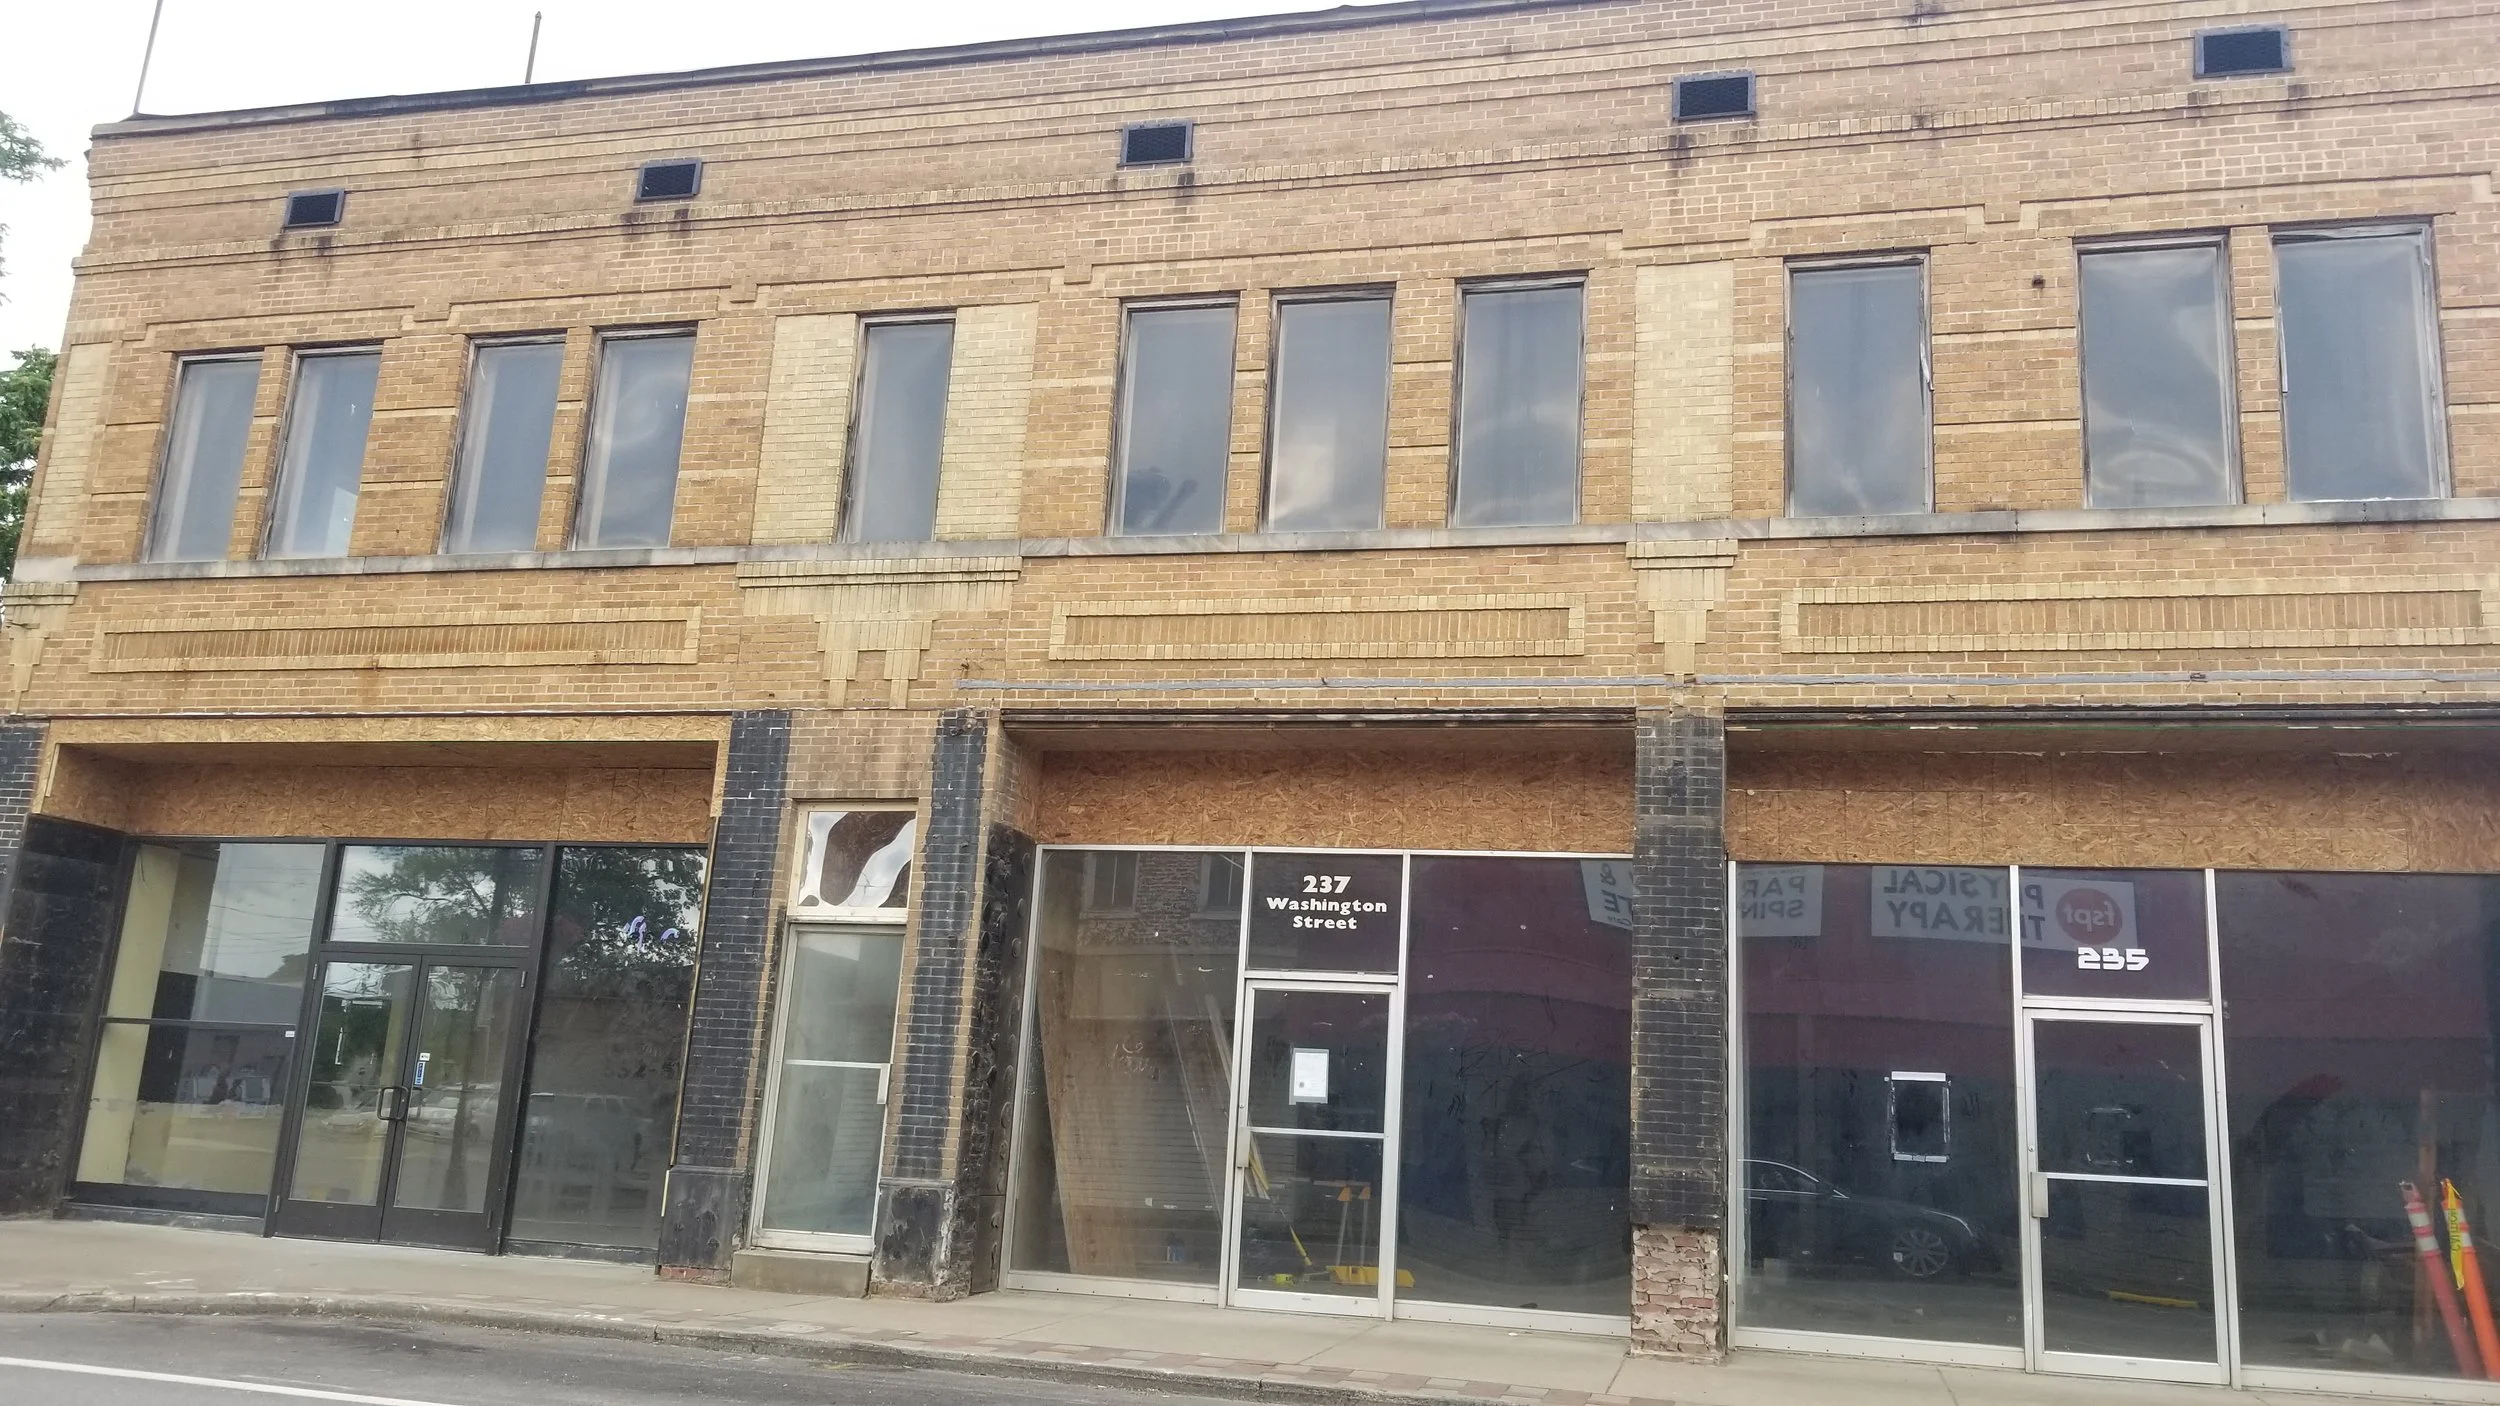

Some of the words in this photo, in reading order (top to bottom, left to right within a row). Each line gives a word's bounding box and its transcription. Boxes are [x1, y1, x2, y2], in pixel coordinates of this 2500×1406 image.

[1303, 875, 1352, 893] 237
[1266, 897, 1387, 915] Washington
[1293, 915, 1357, 929] Street
[2078, 947, 2149, 971] 235
